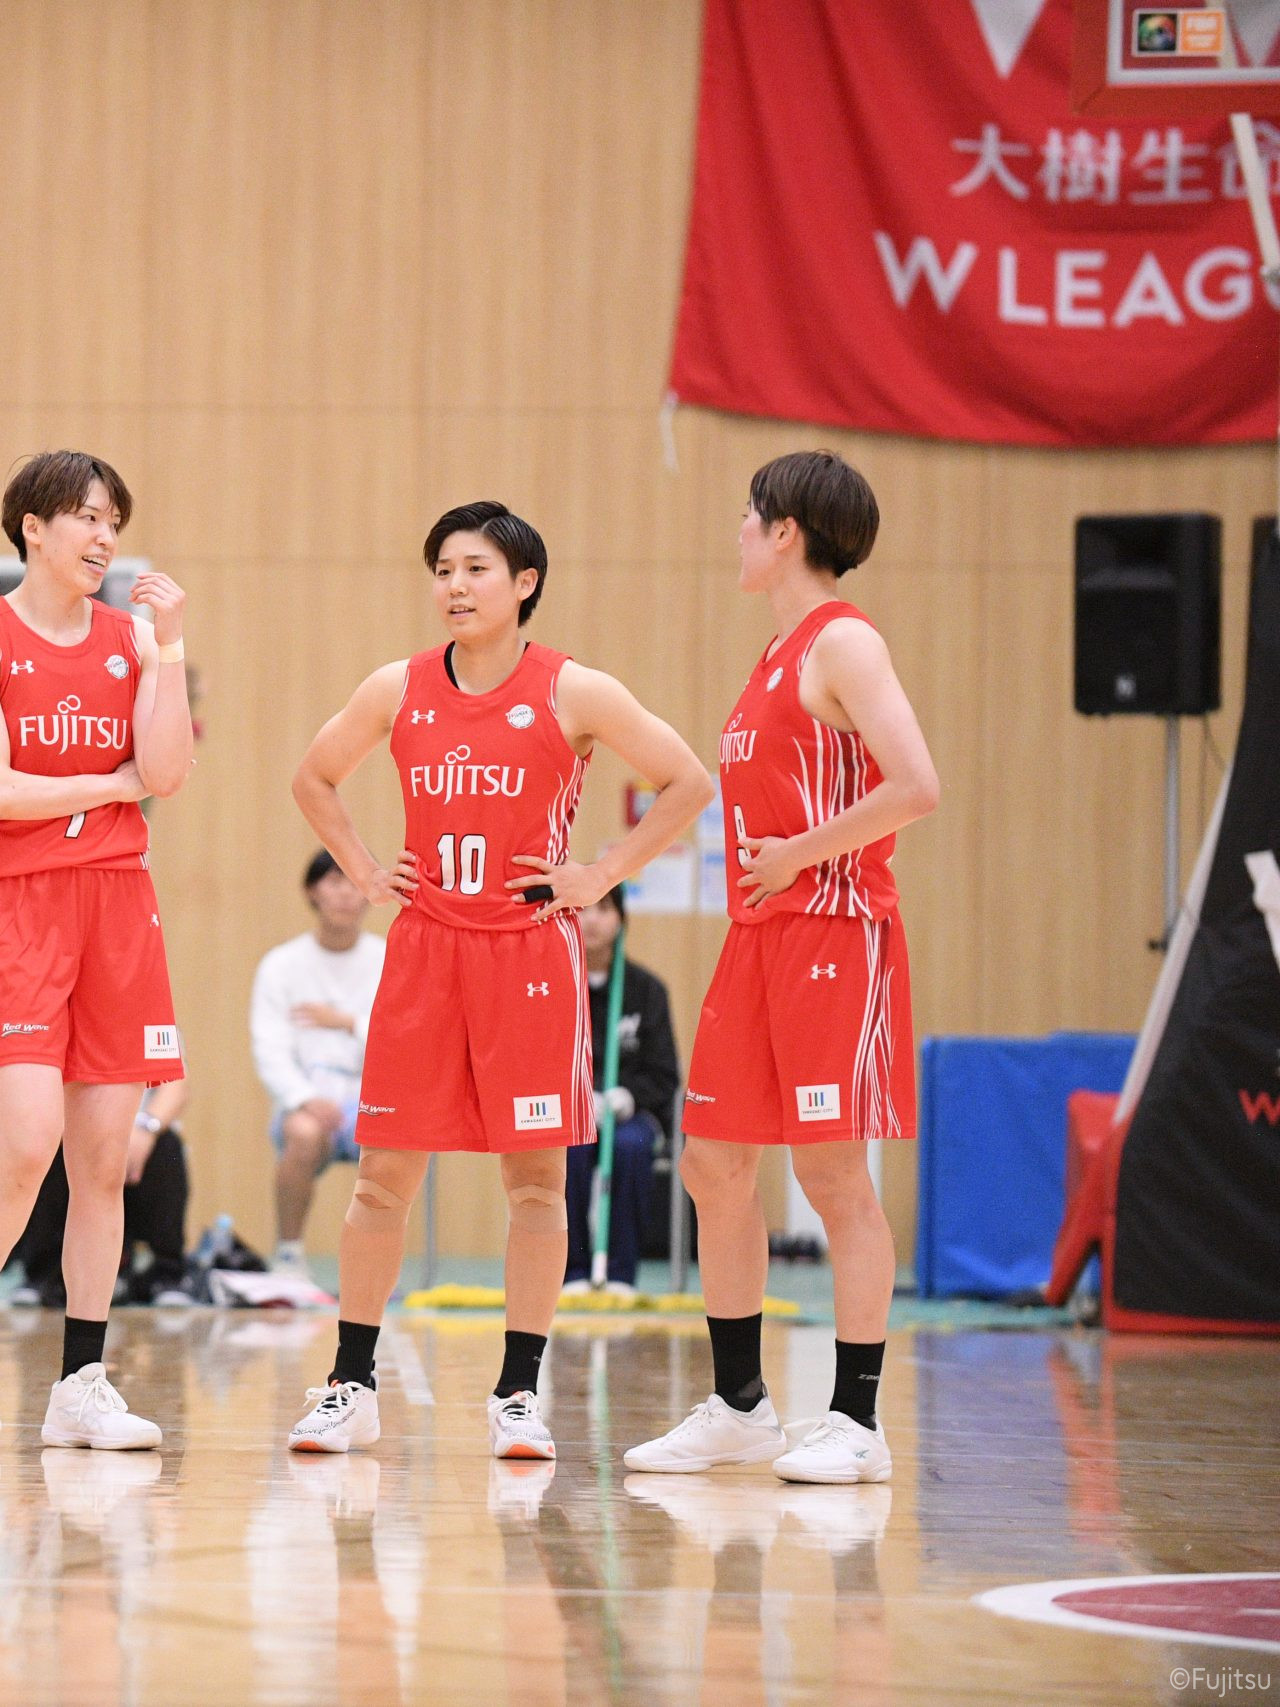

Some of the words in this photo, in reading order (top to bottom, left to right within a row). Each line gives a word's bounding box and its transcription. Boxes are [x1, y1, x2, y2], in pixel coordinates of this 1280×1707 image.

[873, 229, 979, 314] W
[997, 247, 1280, 328] LEAG
[19, 714, 128, 755] FUJITSU
[410, 764, 526, 805] FUJITSU
[437, 832, 487, 896] 10
[2, 1023, 22, 1032] Red
[23, 1024, 49, 1032] Wave
